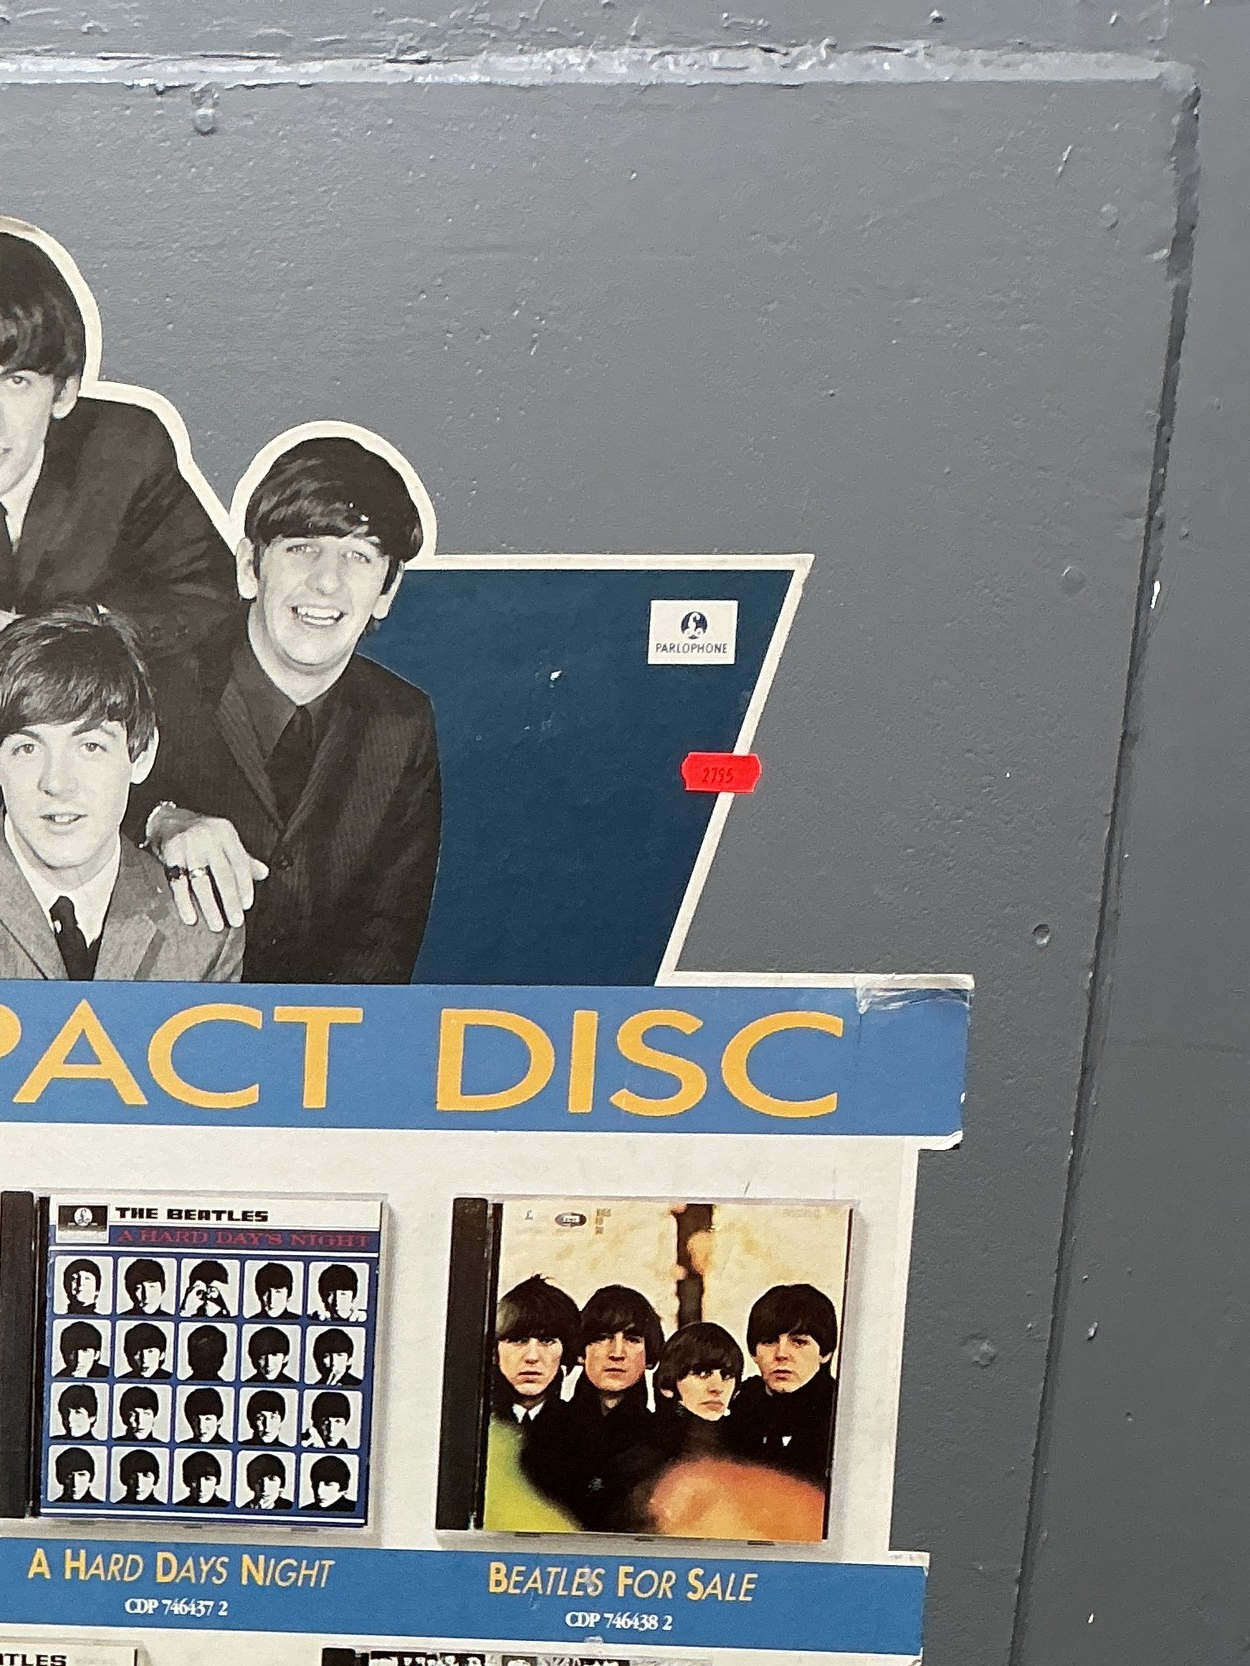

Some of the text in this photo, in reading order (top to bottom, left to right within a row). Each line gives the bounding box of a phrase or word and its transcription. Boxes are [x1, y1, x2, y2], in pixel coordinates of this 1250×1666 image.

[655, 642, 728, 654] PARLOPHONE
[436, 1006, 845, 1118] DISC
[115, 1207, 268, 1223] THE BEATLES
[117, 1229, 130, 1243] A
[140, 1230, 208, 1244] HARD
[216, 1231, 283, 1246] DAY'S
[290, 1233, 371, 1249] NIGHT
[27, 1548, 336, 1588] A HARD DAYS NIGHT
[488, 1562, 758, 1602] BEATLES FOR SALE
[125, 1598, 227, 1617] CDP 746437 2
[565, 1612, 672, 1631] CDP 746438 2
